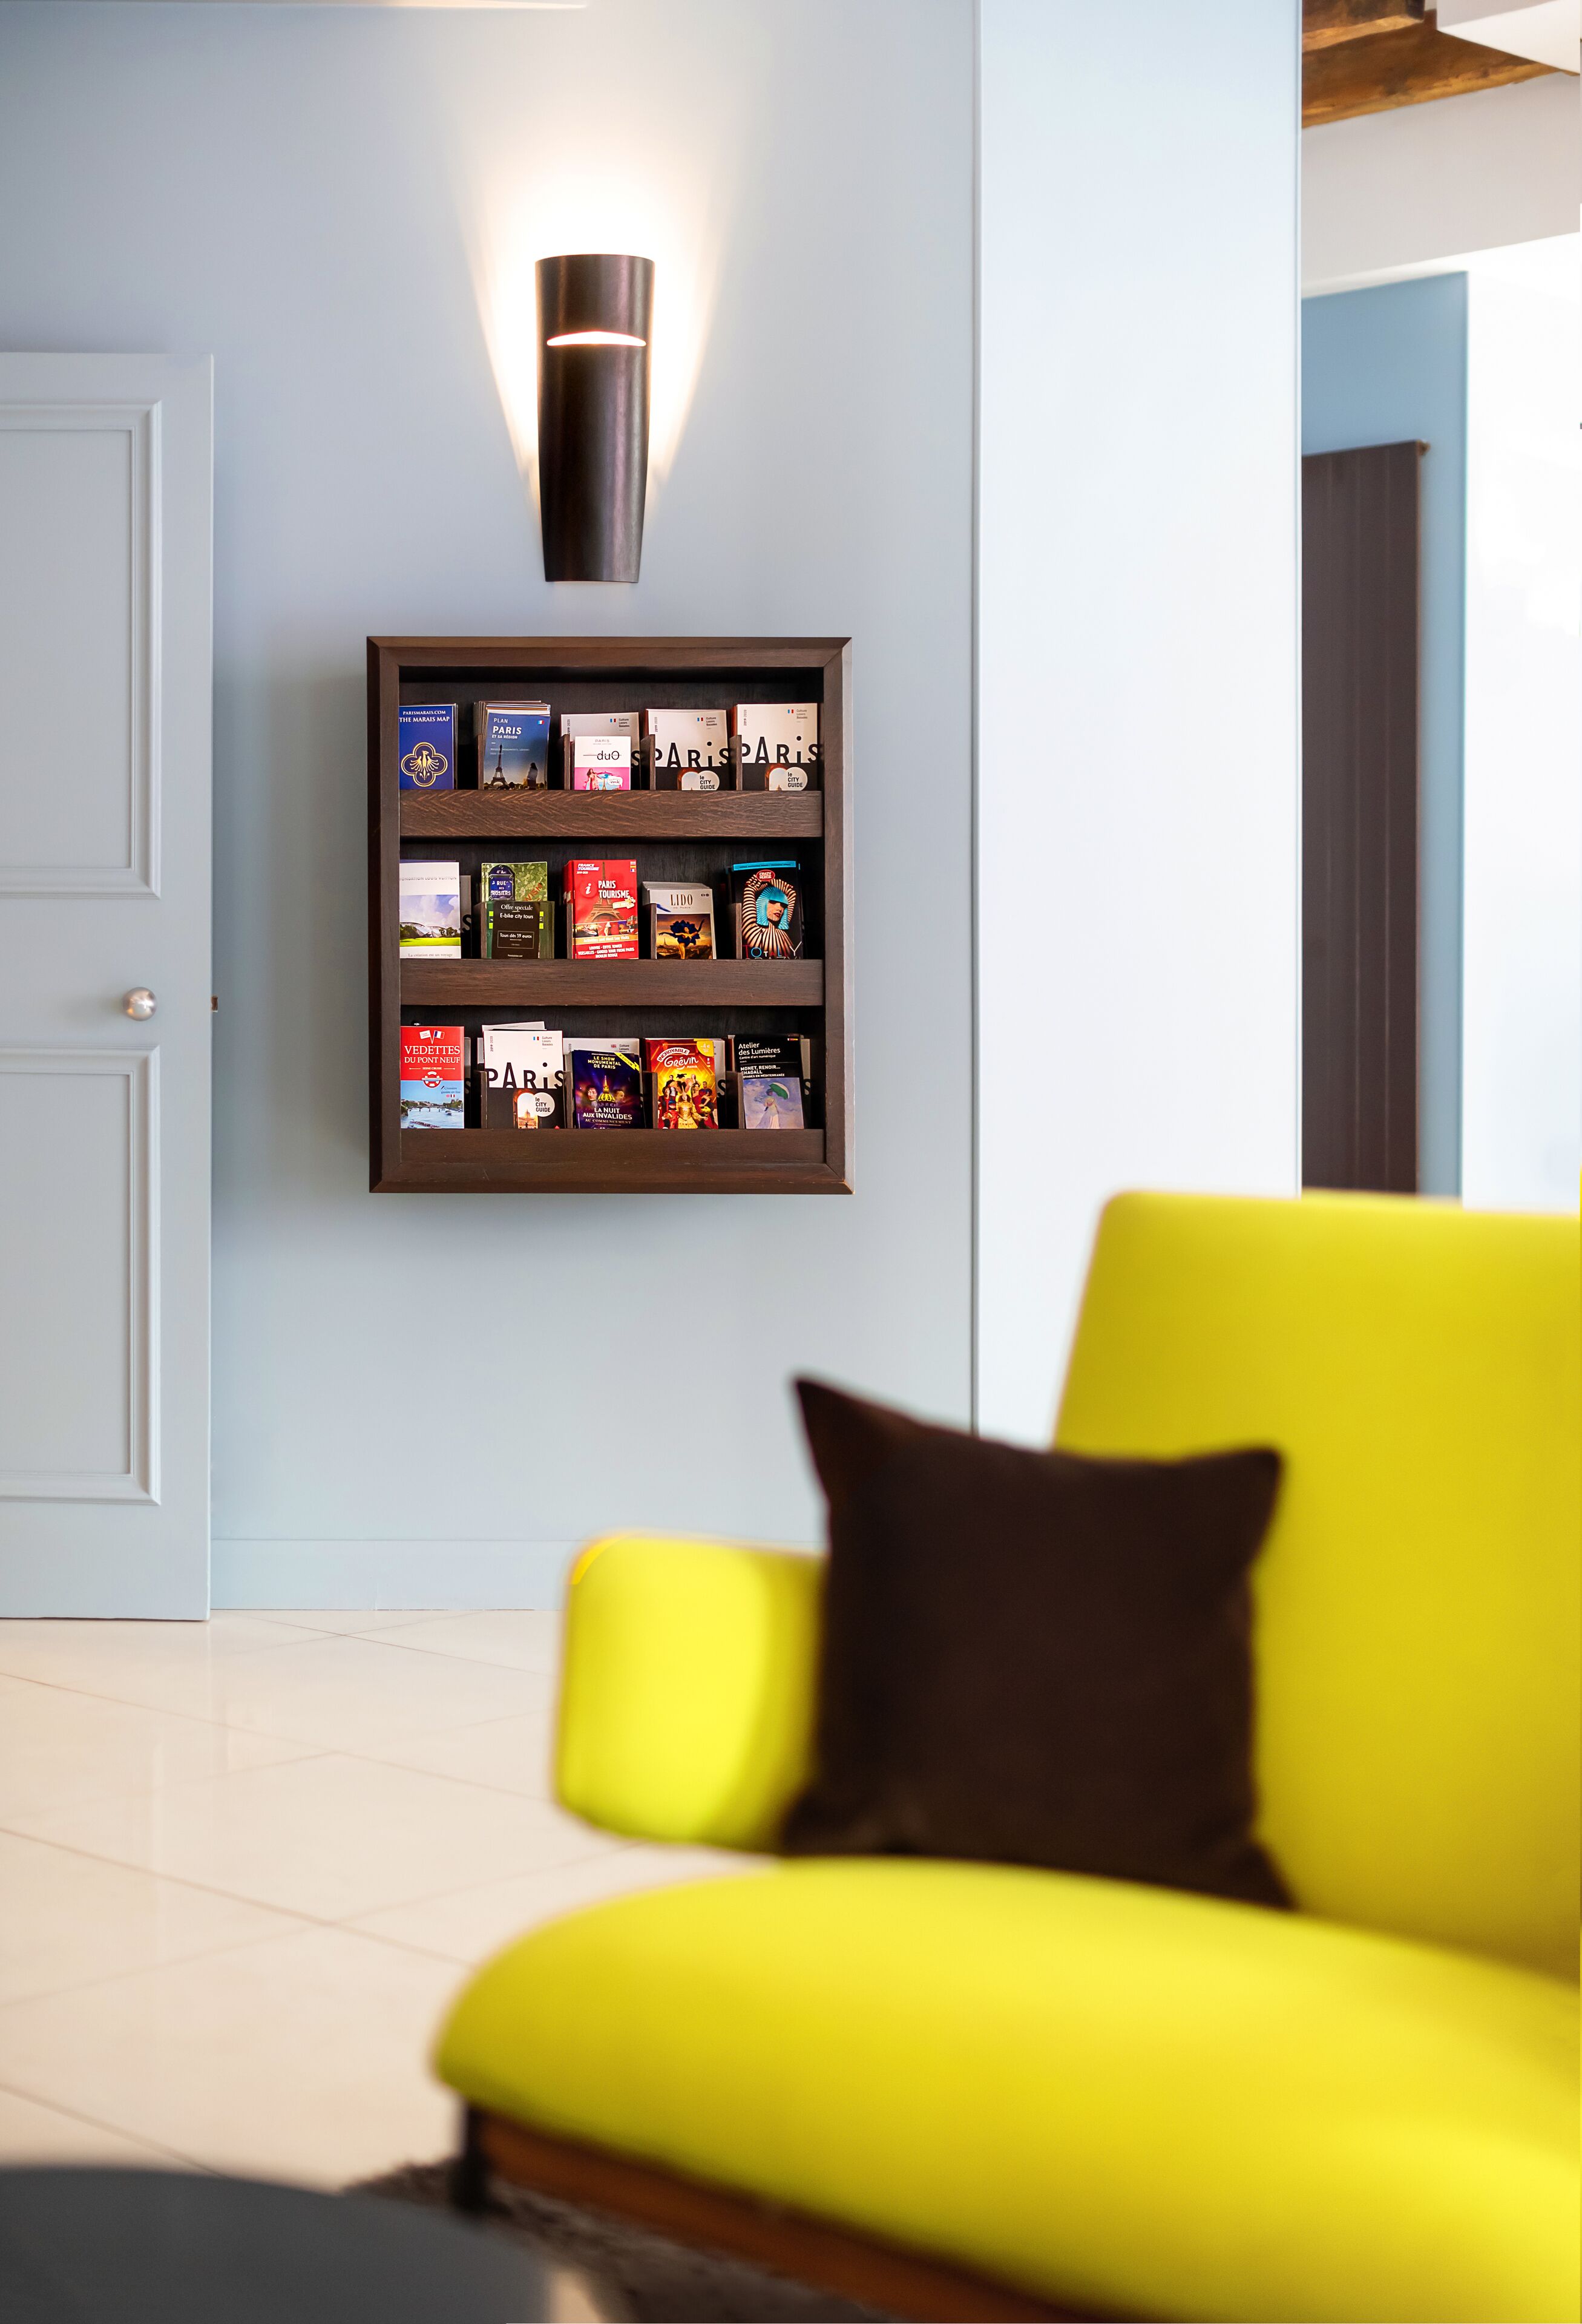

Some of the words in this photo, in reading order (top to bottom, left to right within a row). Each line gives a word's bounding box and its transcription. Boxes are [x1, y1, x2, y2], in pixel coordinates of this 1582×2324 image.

[493, 726, 522, 734] PARIS
[598, 881, 616, 889] PARIS
[599, 890, 629, 898] TOURISME
[671, 894, 693, 906] LIDO
[405, 1045, 460, 1055] VEDETTES
[658, 1048, 688, 1061] INCROYABLE
